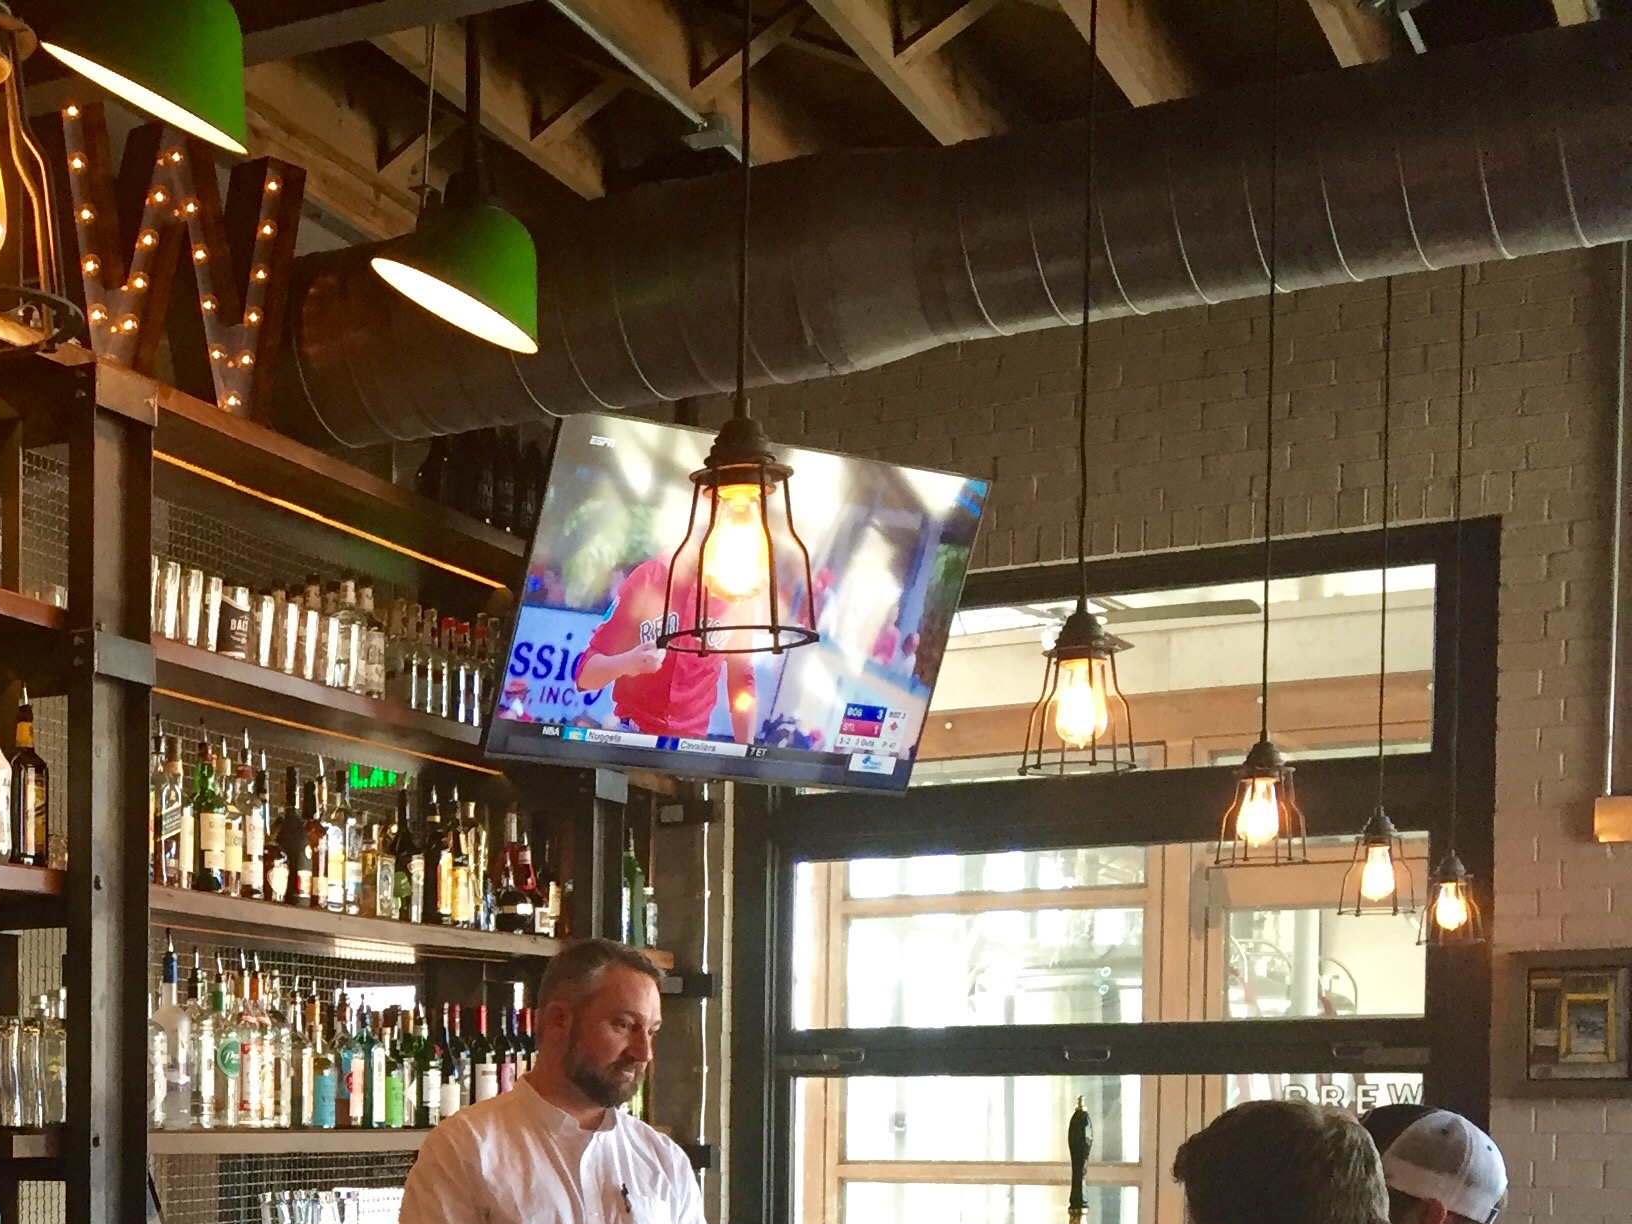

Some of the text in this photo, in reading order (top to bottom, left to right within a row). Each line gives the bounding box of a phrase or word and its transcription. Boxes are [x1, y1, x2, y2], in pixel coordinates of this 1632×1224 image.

[590, 435, 616, 449] ESPN
[539, 686, 579, 706] INC.
[876, 709, 884, 720] 3
[542, 726, 560, 736] NBA
[588, 731, 621, 744] Nuggets
[680, 741, 716, 752] Cavaliers
[755, 749, 767, 757] ET
